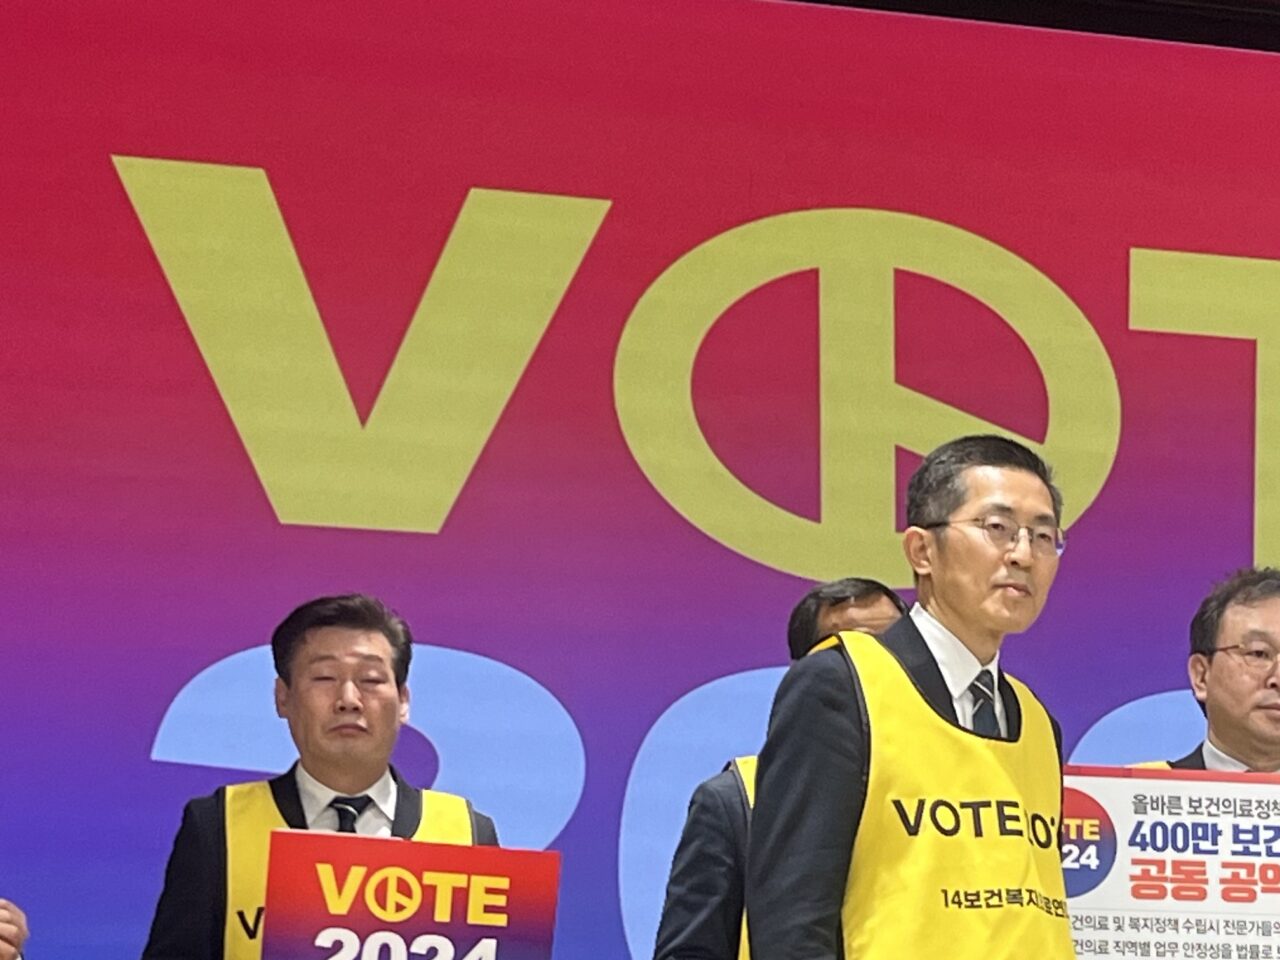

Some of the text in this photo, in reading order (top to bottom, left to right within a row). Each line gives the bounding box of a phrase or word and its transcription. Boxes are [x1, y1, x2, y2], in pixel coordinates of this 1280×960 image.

[1132, 794, 1183, 816] 올바른
[892, 799, 1024, 838] VOTE
[1063, 818, 1101, 841] TE
[1128, 820, 1222, 855] 400만
[1063, 844, 1100, 870] 24
[1129, 858, 1209, 901] 공동
[315, 862, 511, 927] VOTE
[1072, 915, 1110, 931] 건의료
[1112, 916, 1125, 932] 및
[1128, 916, 1180, 934] 복지정책
[1182, 918, 1220, 935] 수립시
[1072, 939, 1110, 955] 건의료
[1113, 940, 1151, 957] 직역별
[1154, 941, 1179, 957] 업무
[1182, 942, 1232, 960] 안정성을
[1236, 943, 1273, 960] 법률로
